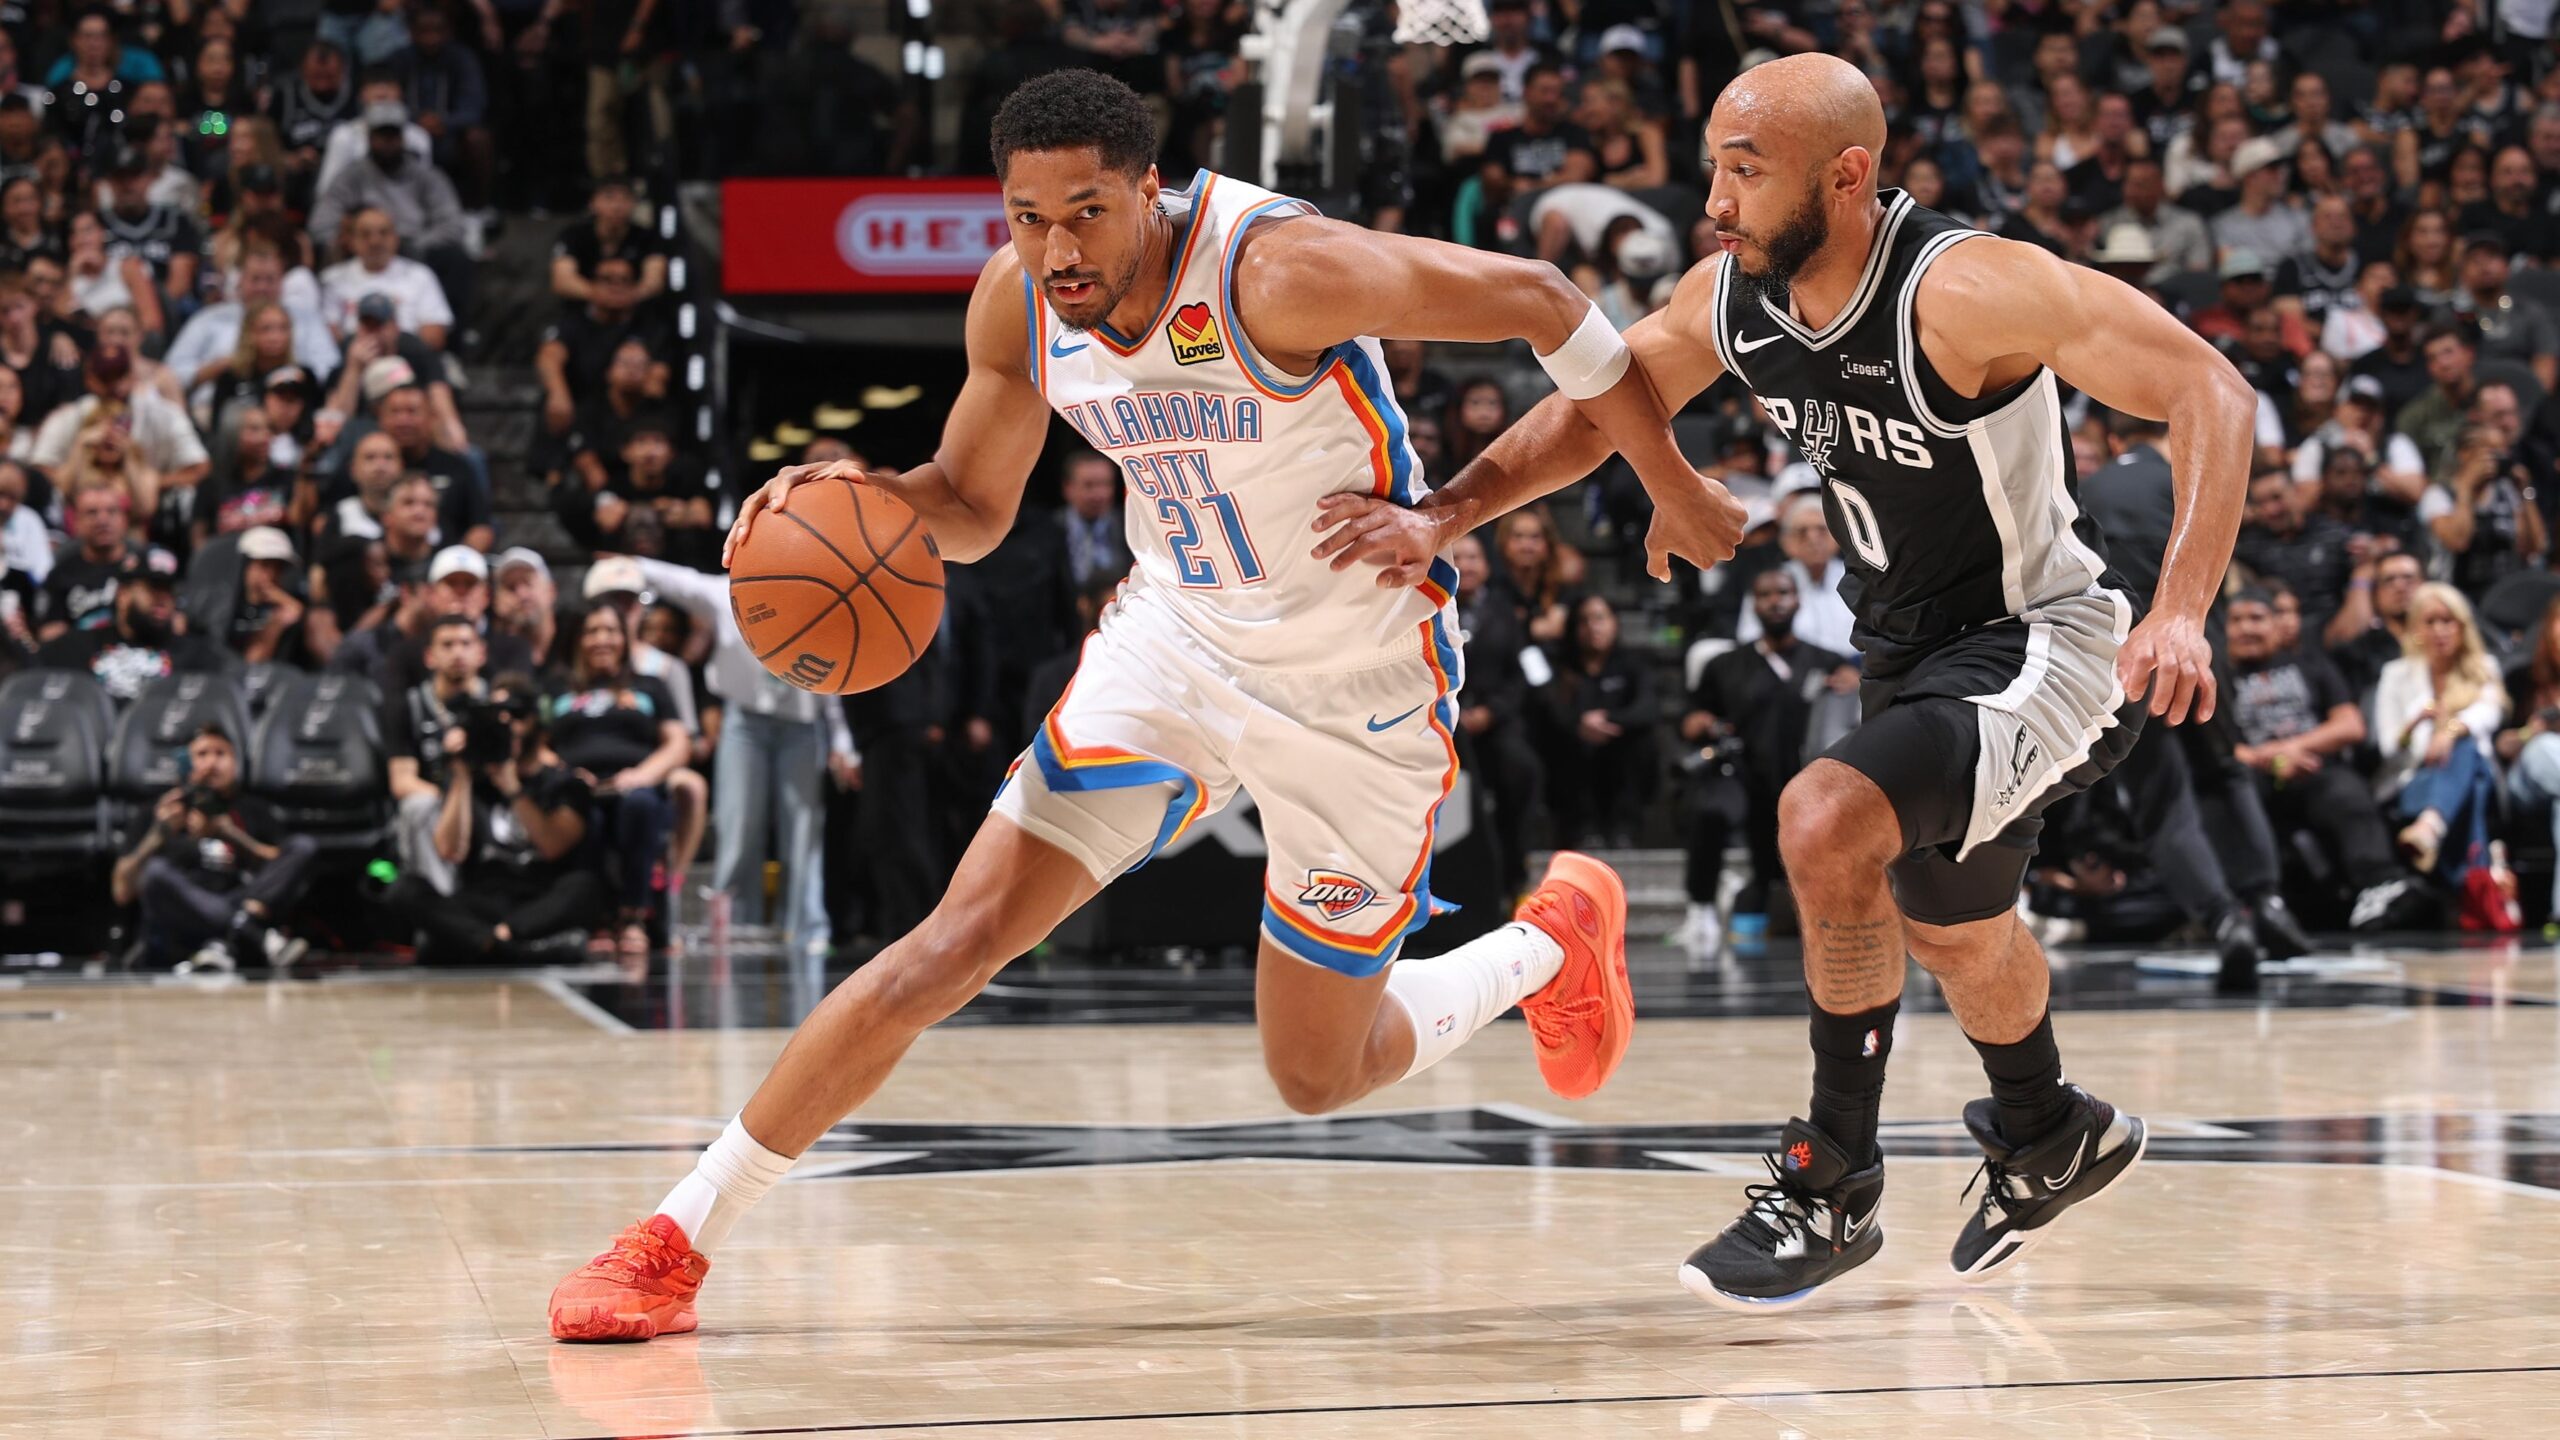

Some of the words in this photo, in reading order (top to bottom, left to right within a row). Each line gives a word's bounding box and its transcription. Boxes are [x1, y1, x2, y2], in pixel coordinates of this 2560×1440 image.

[1846, 361, 1887, 377] LEDGER
[1063, 391, 1262, 450] KLAHOMA
[1121, 449, 1221, 499] CITY
[1156, 491, 1267, 589] 21
[1828, 477, 1889, 573] 0
[1298, 883, 1364, 902] OKC
